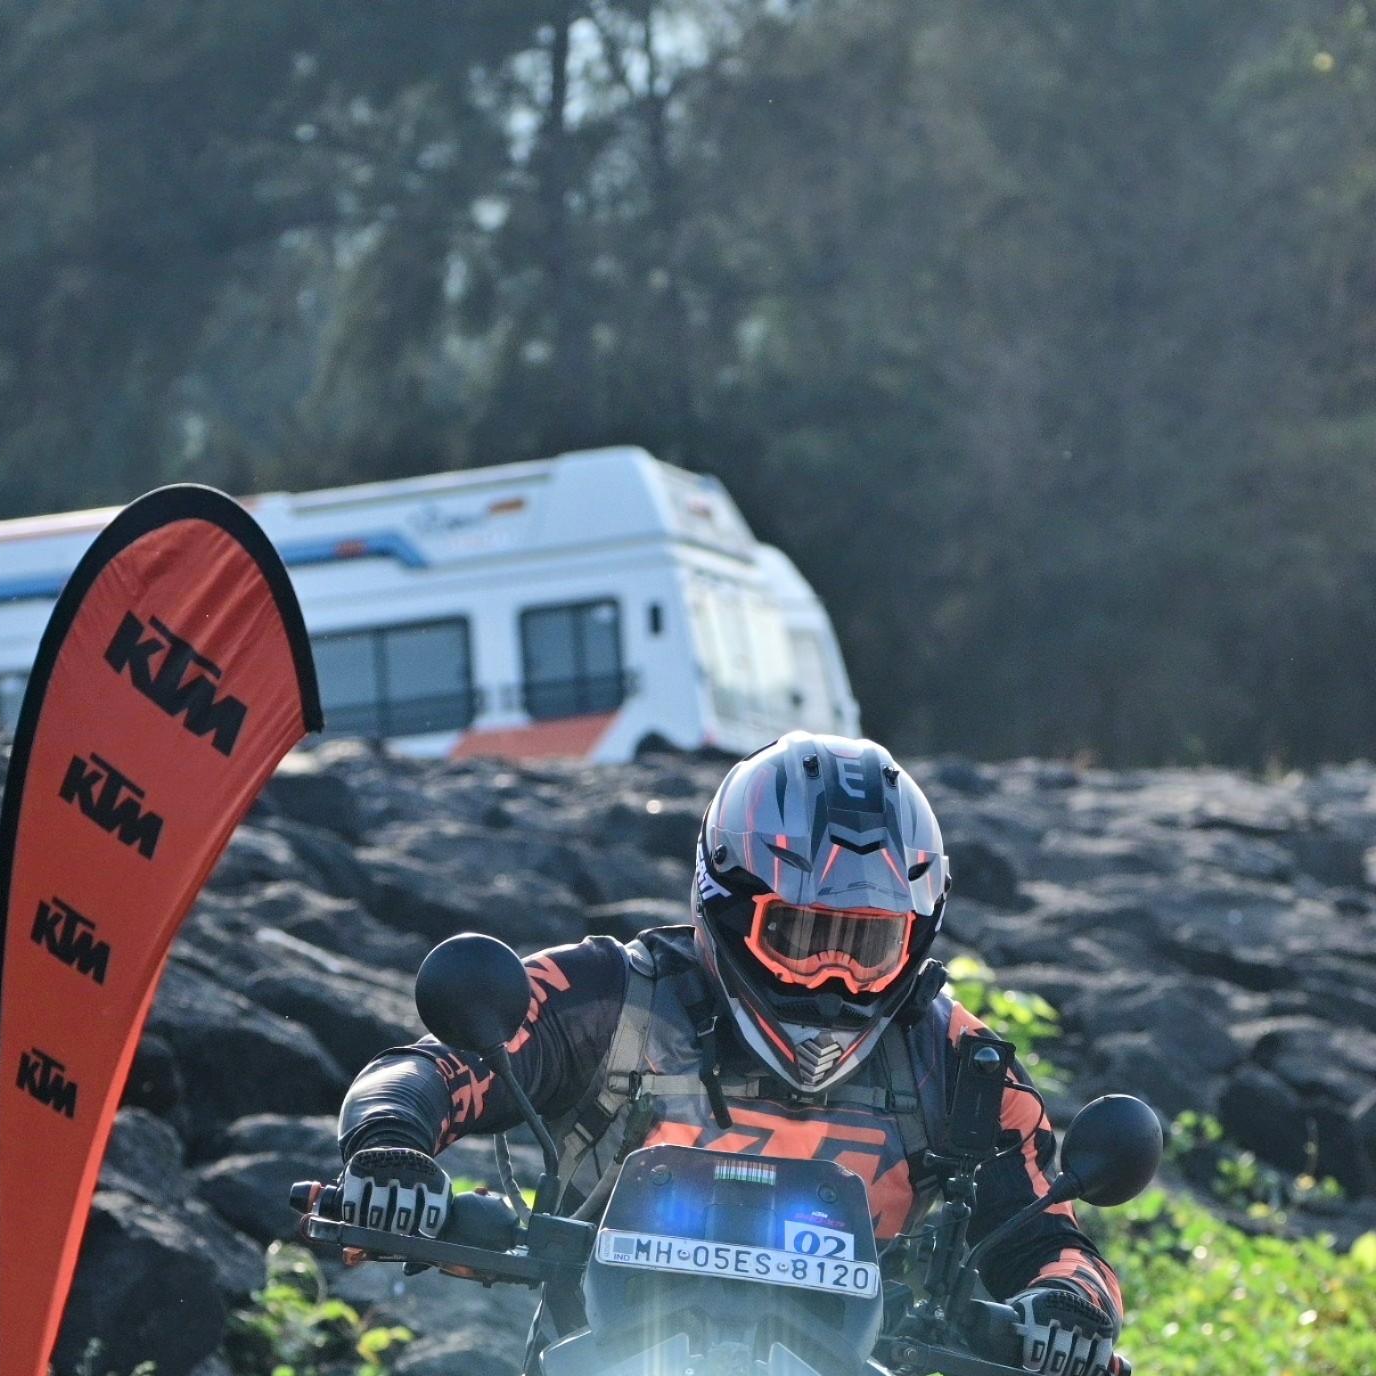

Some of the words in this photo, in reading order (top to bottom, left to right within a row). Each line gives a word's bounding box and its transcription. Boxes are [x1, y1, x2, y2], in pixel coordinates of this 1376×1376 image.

[104, 610, 247, 756] KTM
[59, 752, 164, 859] KTM
[31, 896, 111, 985] KTM
[16, 1047, 77, 1119] KTM
[614, 1253, 630, 1261] IND
[635, 1238, 672, 1264] MH
[693, 1245, 771, 1275] 05ES
[791, 1258, 869, 1289] 8120
[794, 1231, 846, 1260] 02
